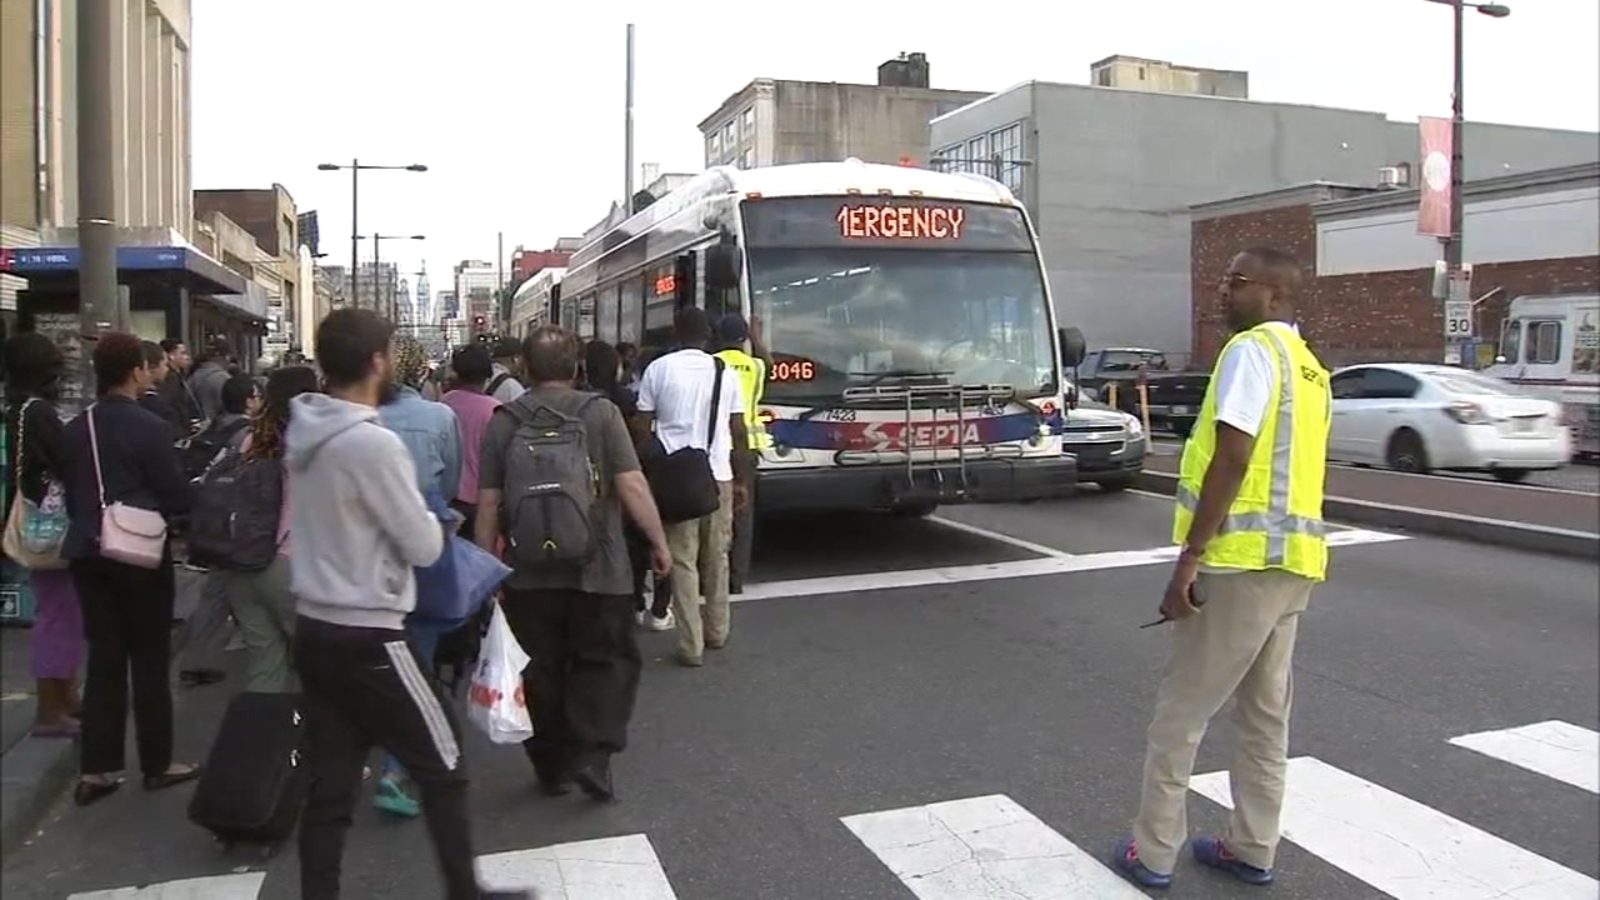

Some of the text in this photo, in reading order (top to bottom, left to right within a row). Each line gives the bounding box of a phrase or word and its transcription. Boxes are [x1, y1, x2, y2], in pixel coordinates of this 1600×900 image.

[1449, 319, 1470, 333] 30
[1300, 365, 1328, 390] SEP
[899, 423, 980, 446] SEPTA
